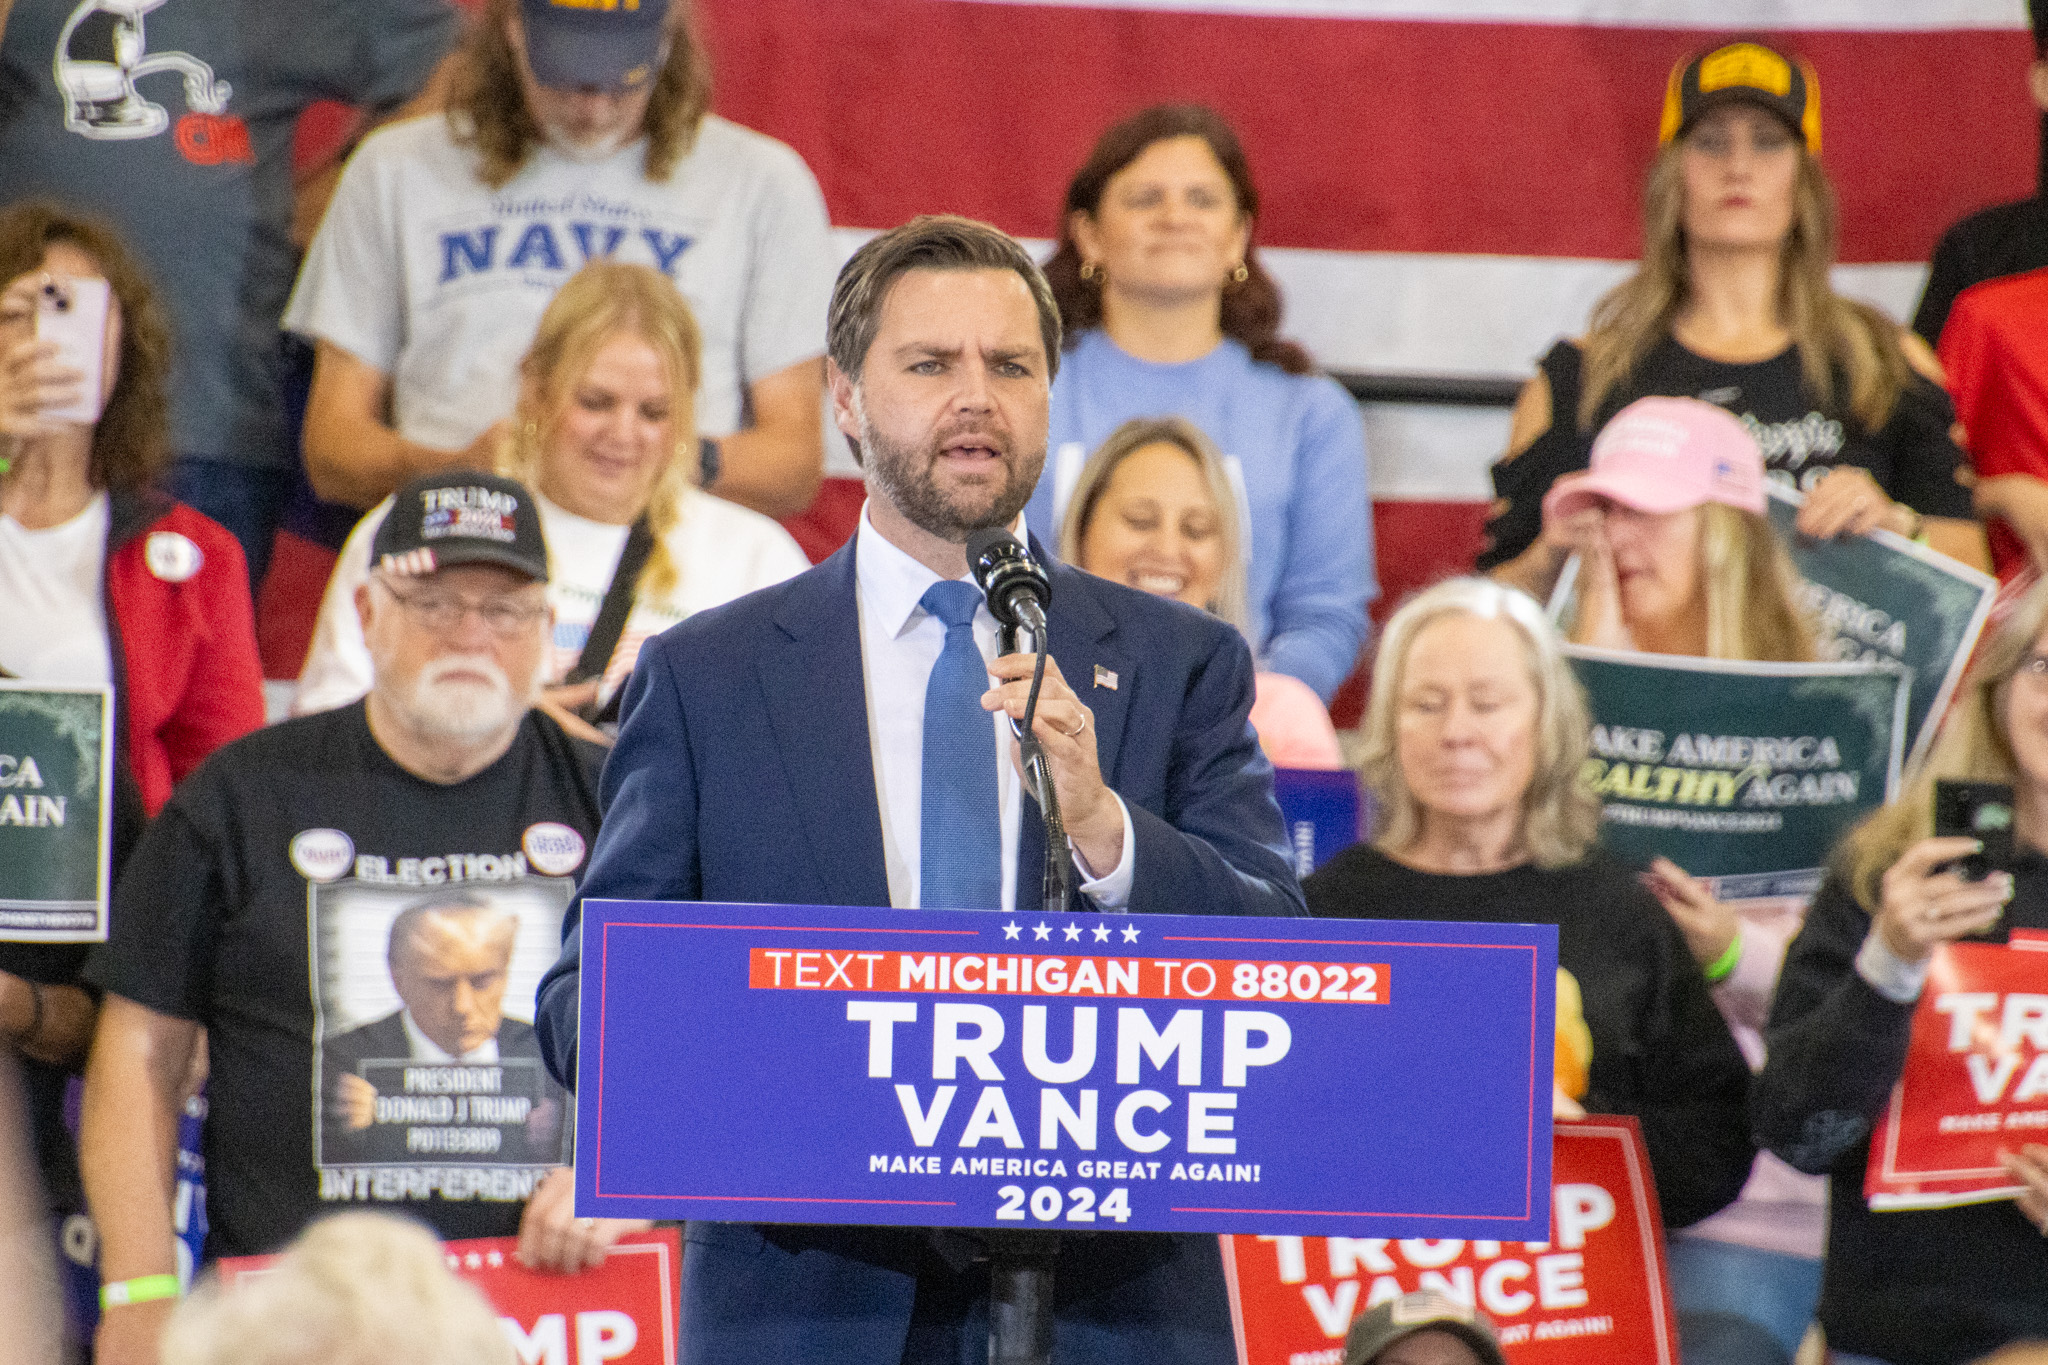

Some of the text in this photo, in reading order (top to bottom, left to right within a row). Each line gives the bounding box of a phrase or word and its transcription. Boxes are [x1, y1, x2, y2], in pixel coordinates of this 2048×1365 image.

[437, 220, 696, 285] NAVY
[1589, 723, 1841, 769] AKE AMERICA
[1744, 770, 1861, 806] AGAIN
[355, 850, 528, 886] ELECTION
[764, 951, 1378, 1002] TEXT MICHIGAN TO 88022
[846, 1000, 1293, 1087] TRUMP
[404, 1066, 503, 1094] PRESIDENT
[375, 1096, 455, 1125] DONALD
[470, 1096, 532, 1125] TRUMP
[894, 1084, 1238, 1155] VANCE
[318, 1167, 544, 1201] INTERFEREN
[869, 1154, 1261, 1183] MAKE AMERICA GREAT AGAIN!
[996, 1185, 1132, 1223] 2024
[1257, 1182, 1616, 1284] TRUP
